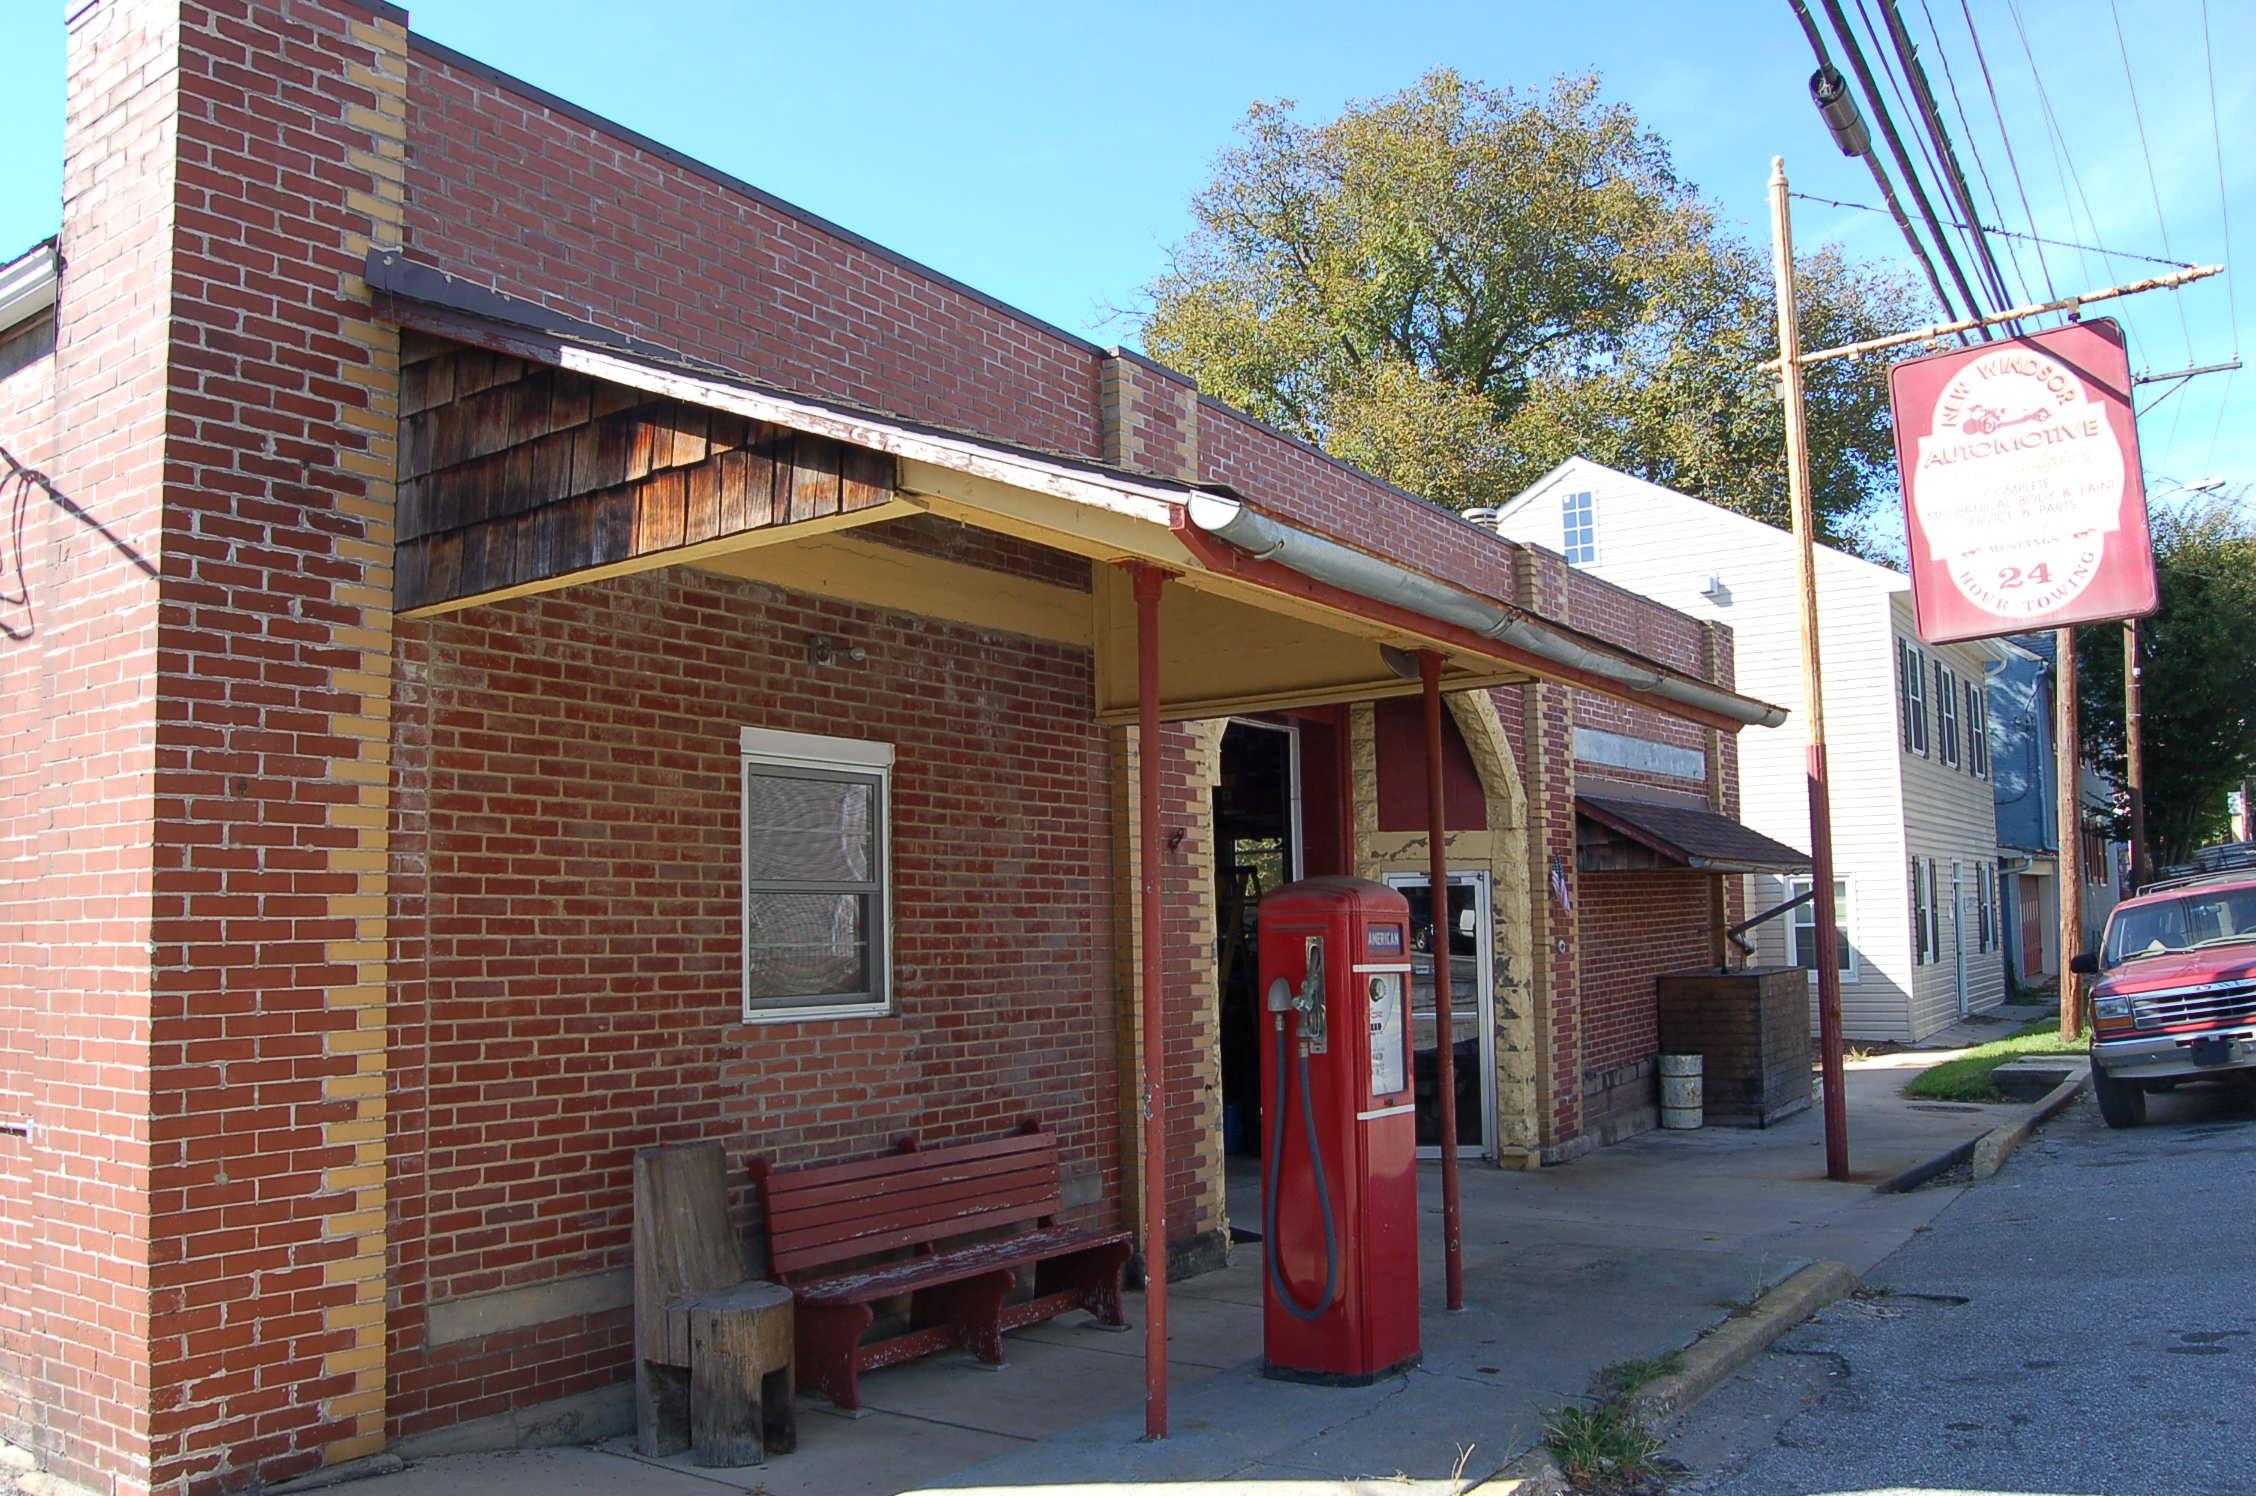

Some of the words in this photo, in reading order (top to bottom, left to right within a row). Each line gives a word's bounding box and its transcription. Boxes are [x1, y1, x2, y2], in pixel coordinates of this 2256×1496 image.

[1940, 381, 1970, 428] NEW
[1976, 356, 2078, 406] WINDSOR
[1923, 418, 2099, 469] AUTOMOTIVE
[1984, 478, 2049, 498] COMPLETE
[2018, 490, 2055, 508] BODY
[2080, 480, 2116, 496] PAINT
[2040, 500, 2078, 517] PARTS
[1988, 535, 2060, 554] MUSTANGS
[1959, 570, 2009, 612] HOUR
[2022, 551, 2096, 612] TOWING
[1998, 561, 2052, 590] 24
[1368, 931, 1400, 946] AMERICAN
